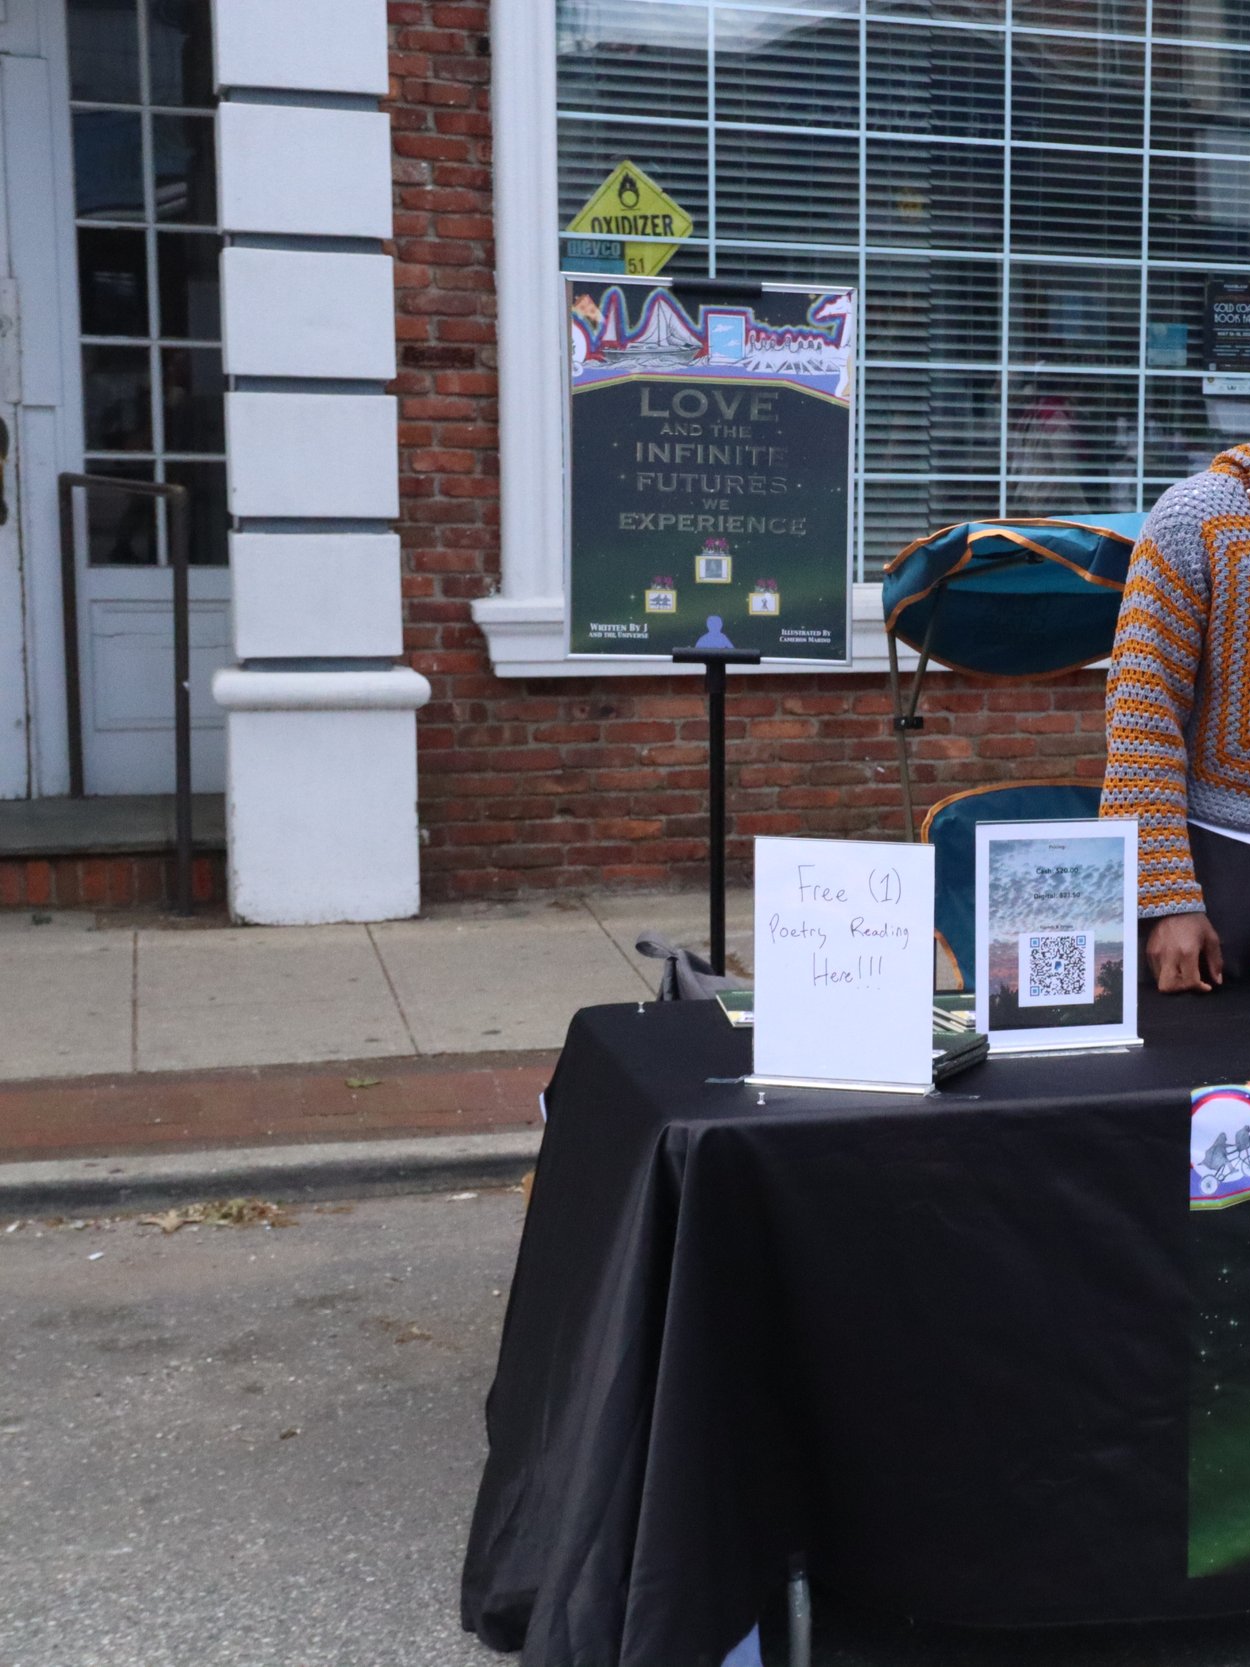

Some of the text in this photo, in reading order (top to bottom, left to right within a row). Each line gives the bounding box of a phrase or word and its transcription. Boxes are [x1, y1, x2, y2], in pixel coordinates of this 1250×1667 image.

[592, 214, 675, 237] OXIDIZER
[1214, 303, 1234, 312] GOLD
[639, 387, 779, 422] LOVE
[660, 423, 751, 438] AND THE
[635, 441, 788, 468] INFINITE
[636, 472, 788, 496] FUTURES
[702, 499, 730, 511] WE
[618, 512, 807, 536] EXPERIENCE
[797, 864, 902, 905] Free (1)
[769, 912, 910, 951] Poetry Reading
